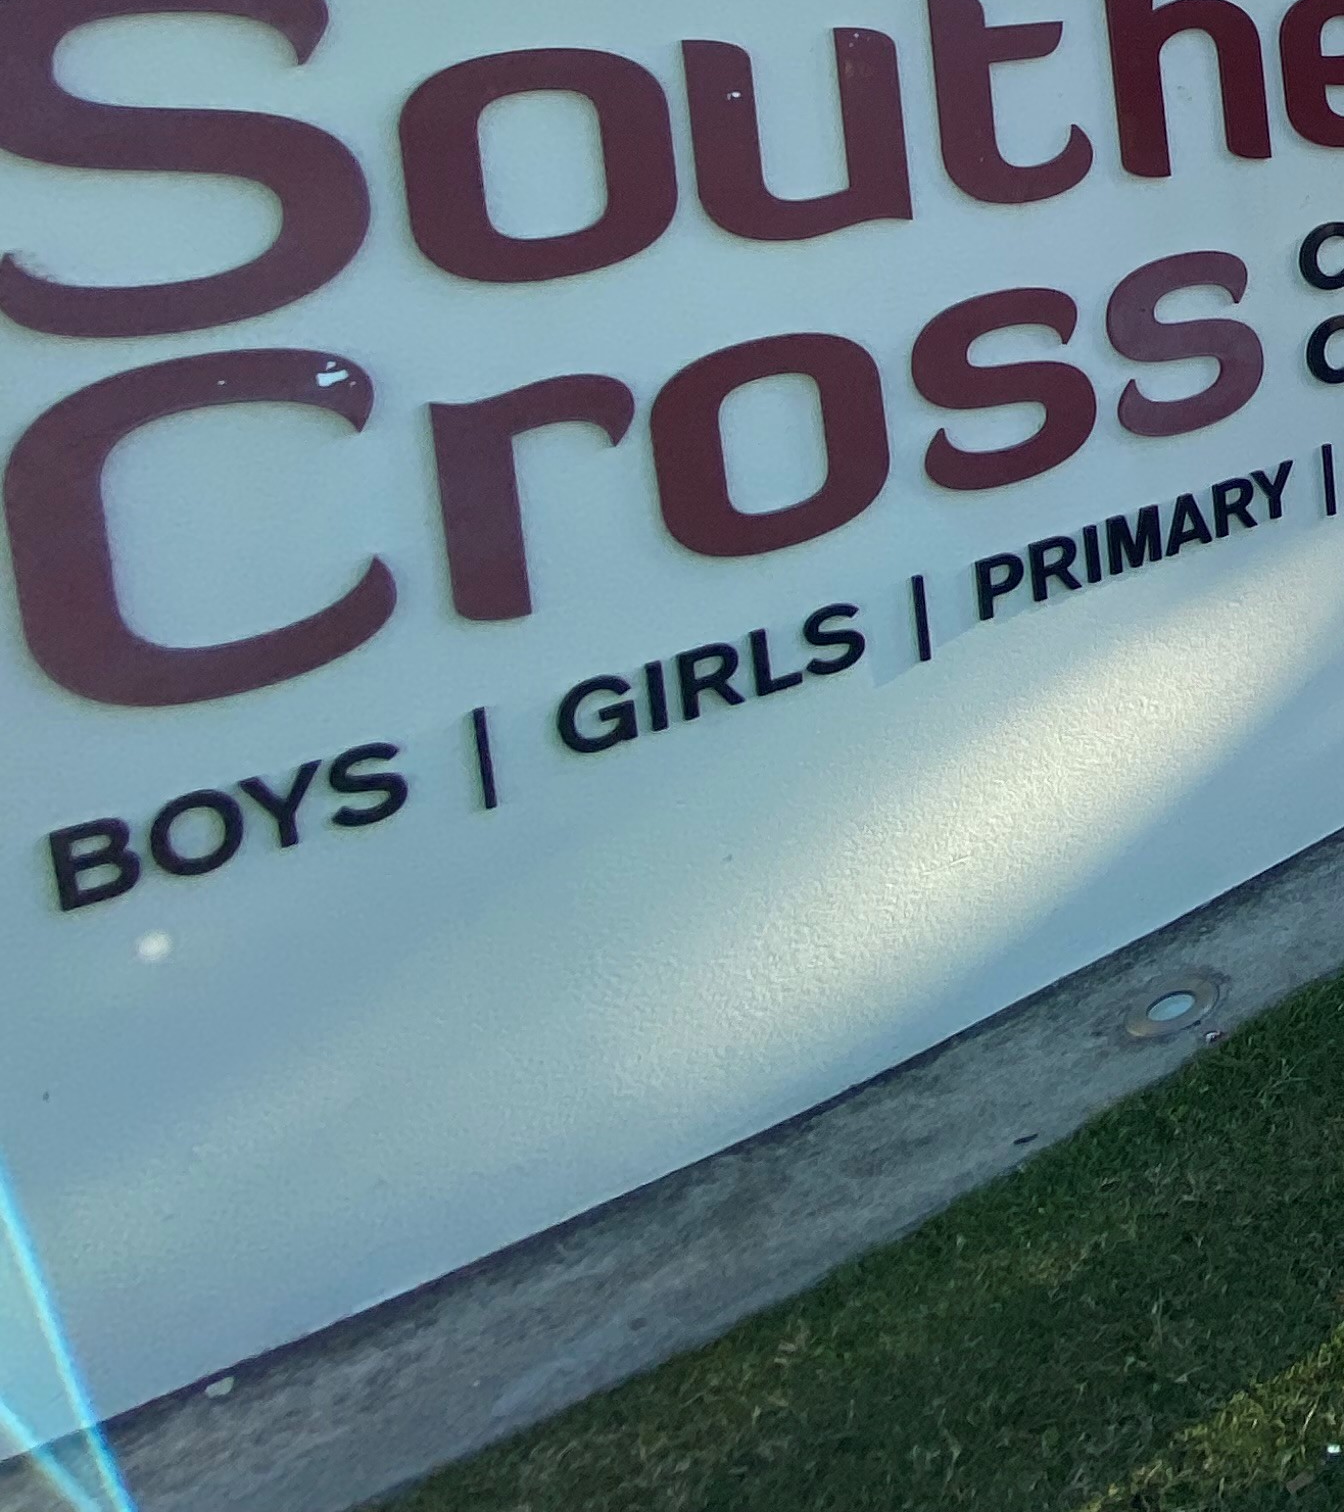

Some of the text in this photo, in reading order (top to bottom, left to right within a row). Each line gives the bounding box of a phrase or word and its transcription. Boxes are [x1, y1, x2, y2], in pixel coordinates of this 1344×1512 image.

[2, 250, 1265, 707] Cross
[48, 742, 409, 913] BOYS
[556, 603, 867, 755] GIRLS
[974, 459, 1294, 621] PRIMARY
